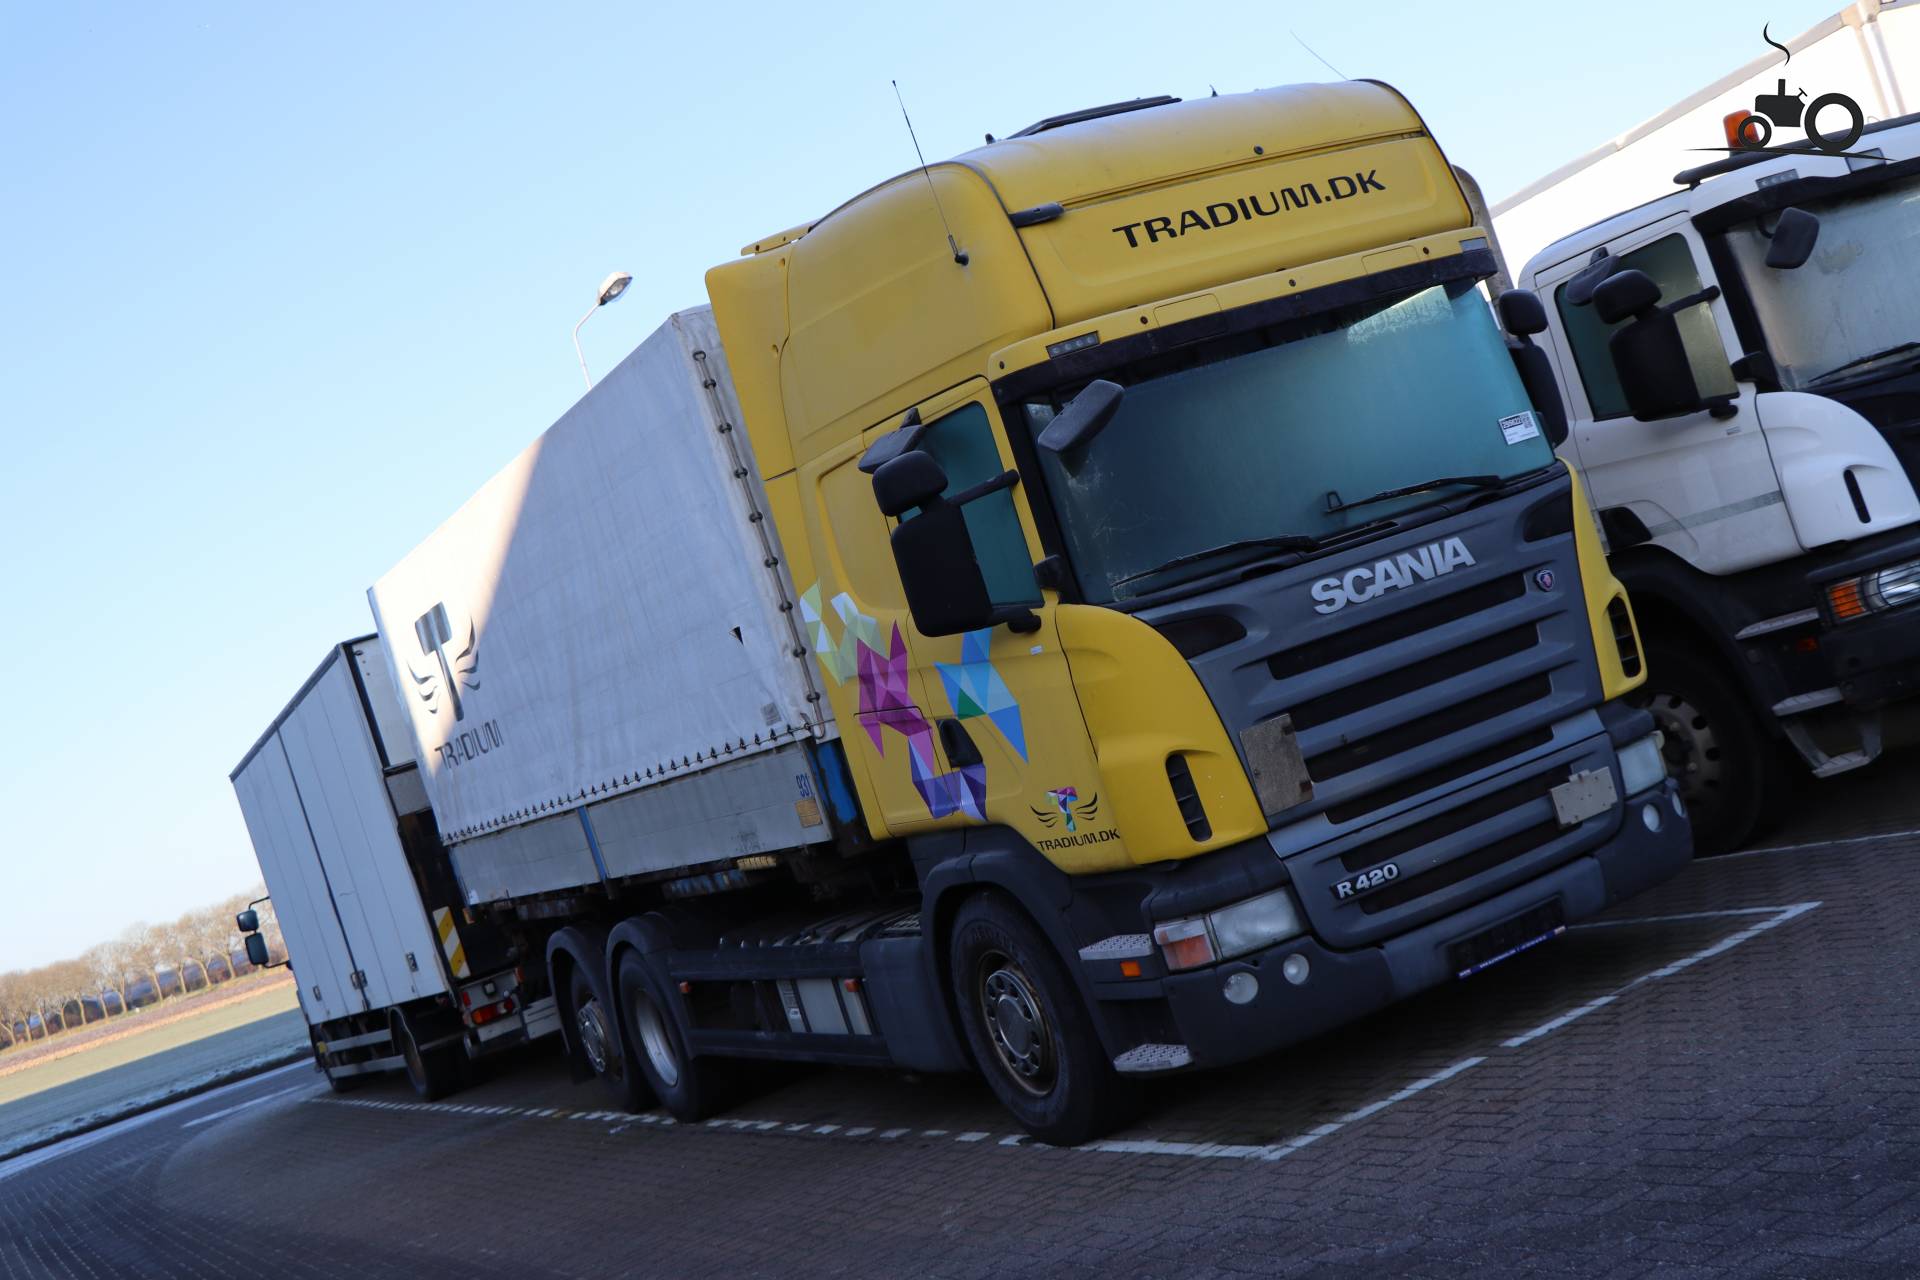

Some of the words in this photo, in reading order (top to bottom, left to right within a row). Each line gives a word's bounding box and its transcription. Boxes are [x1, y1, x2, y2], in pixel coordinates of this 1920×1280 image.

[1112, 169, 1387, 248] TRADIUM.DK
[1310, 536, 1476, 615] SCANIA
[435, 719, 504, 769] TRADIUM
[1037, 829, 1120, 851] TRADIUM.DK
[1336, 882, 1353, 898] R
[1356, 864, 1398, 889] 420
